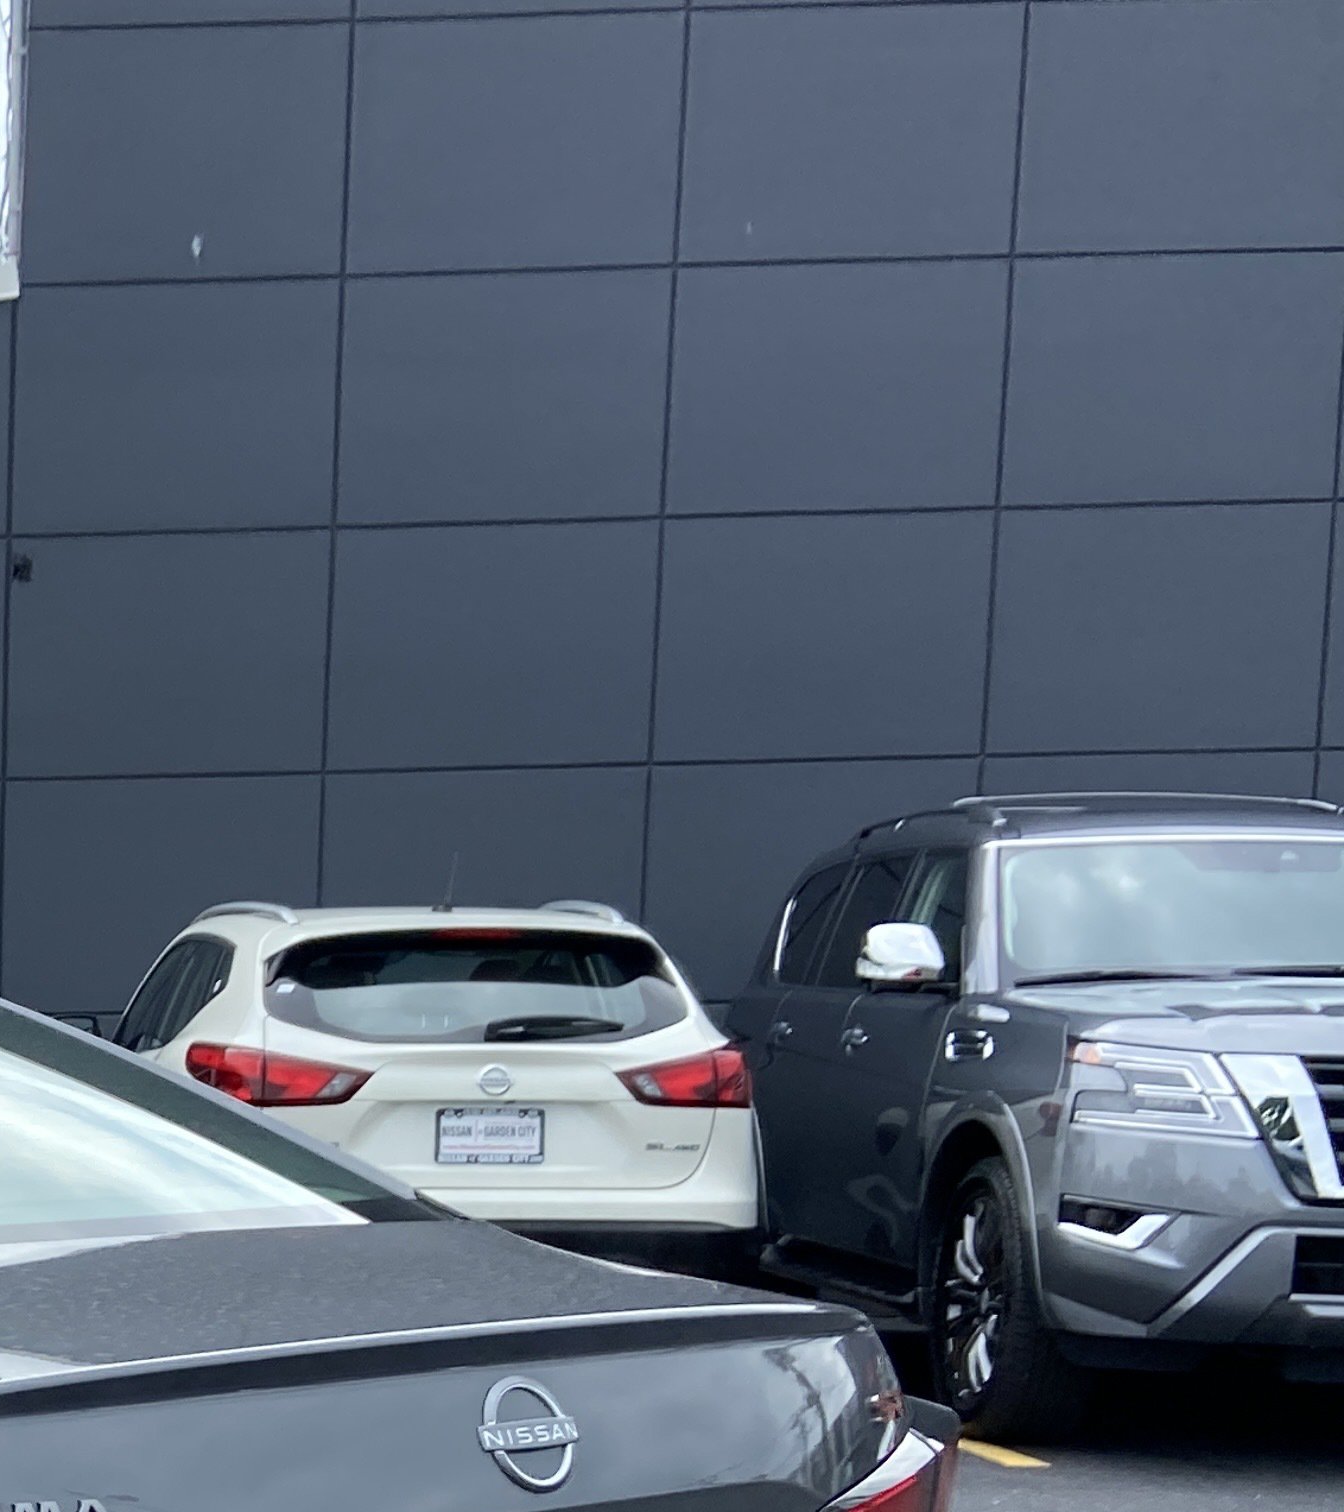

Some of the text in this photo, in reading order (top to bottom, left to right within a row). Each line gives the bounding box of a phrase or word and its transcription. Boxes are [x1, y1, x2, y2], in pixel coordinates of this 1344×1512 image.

[442, 1125, 472, 1137] NISSAN
[484, 1125, 516, 1137] GARDEN
[518, 1125, 537, 1137] CITY
[482, 1422, 578, 1448] NISSAN
